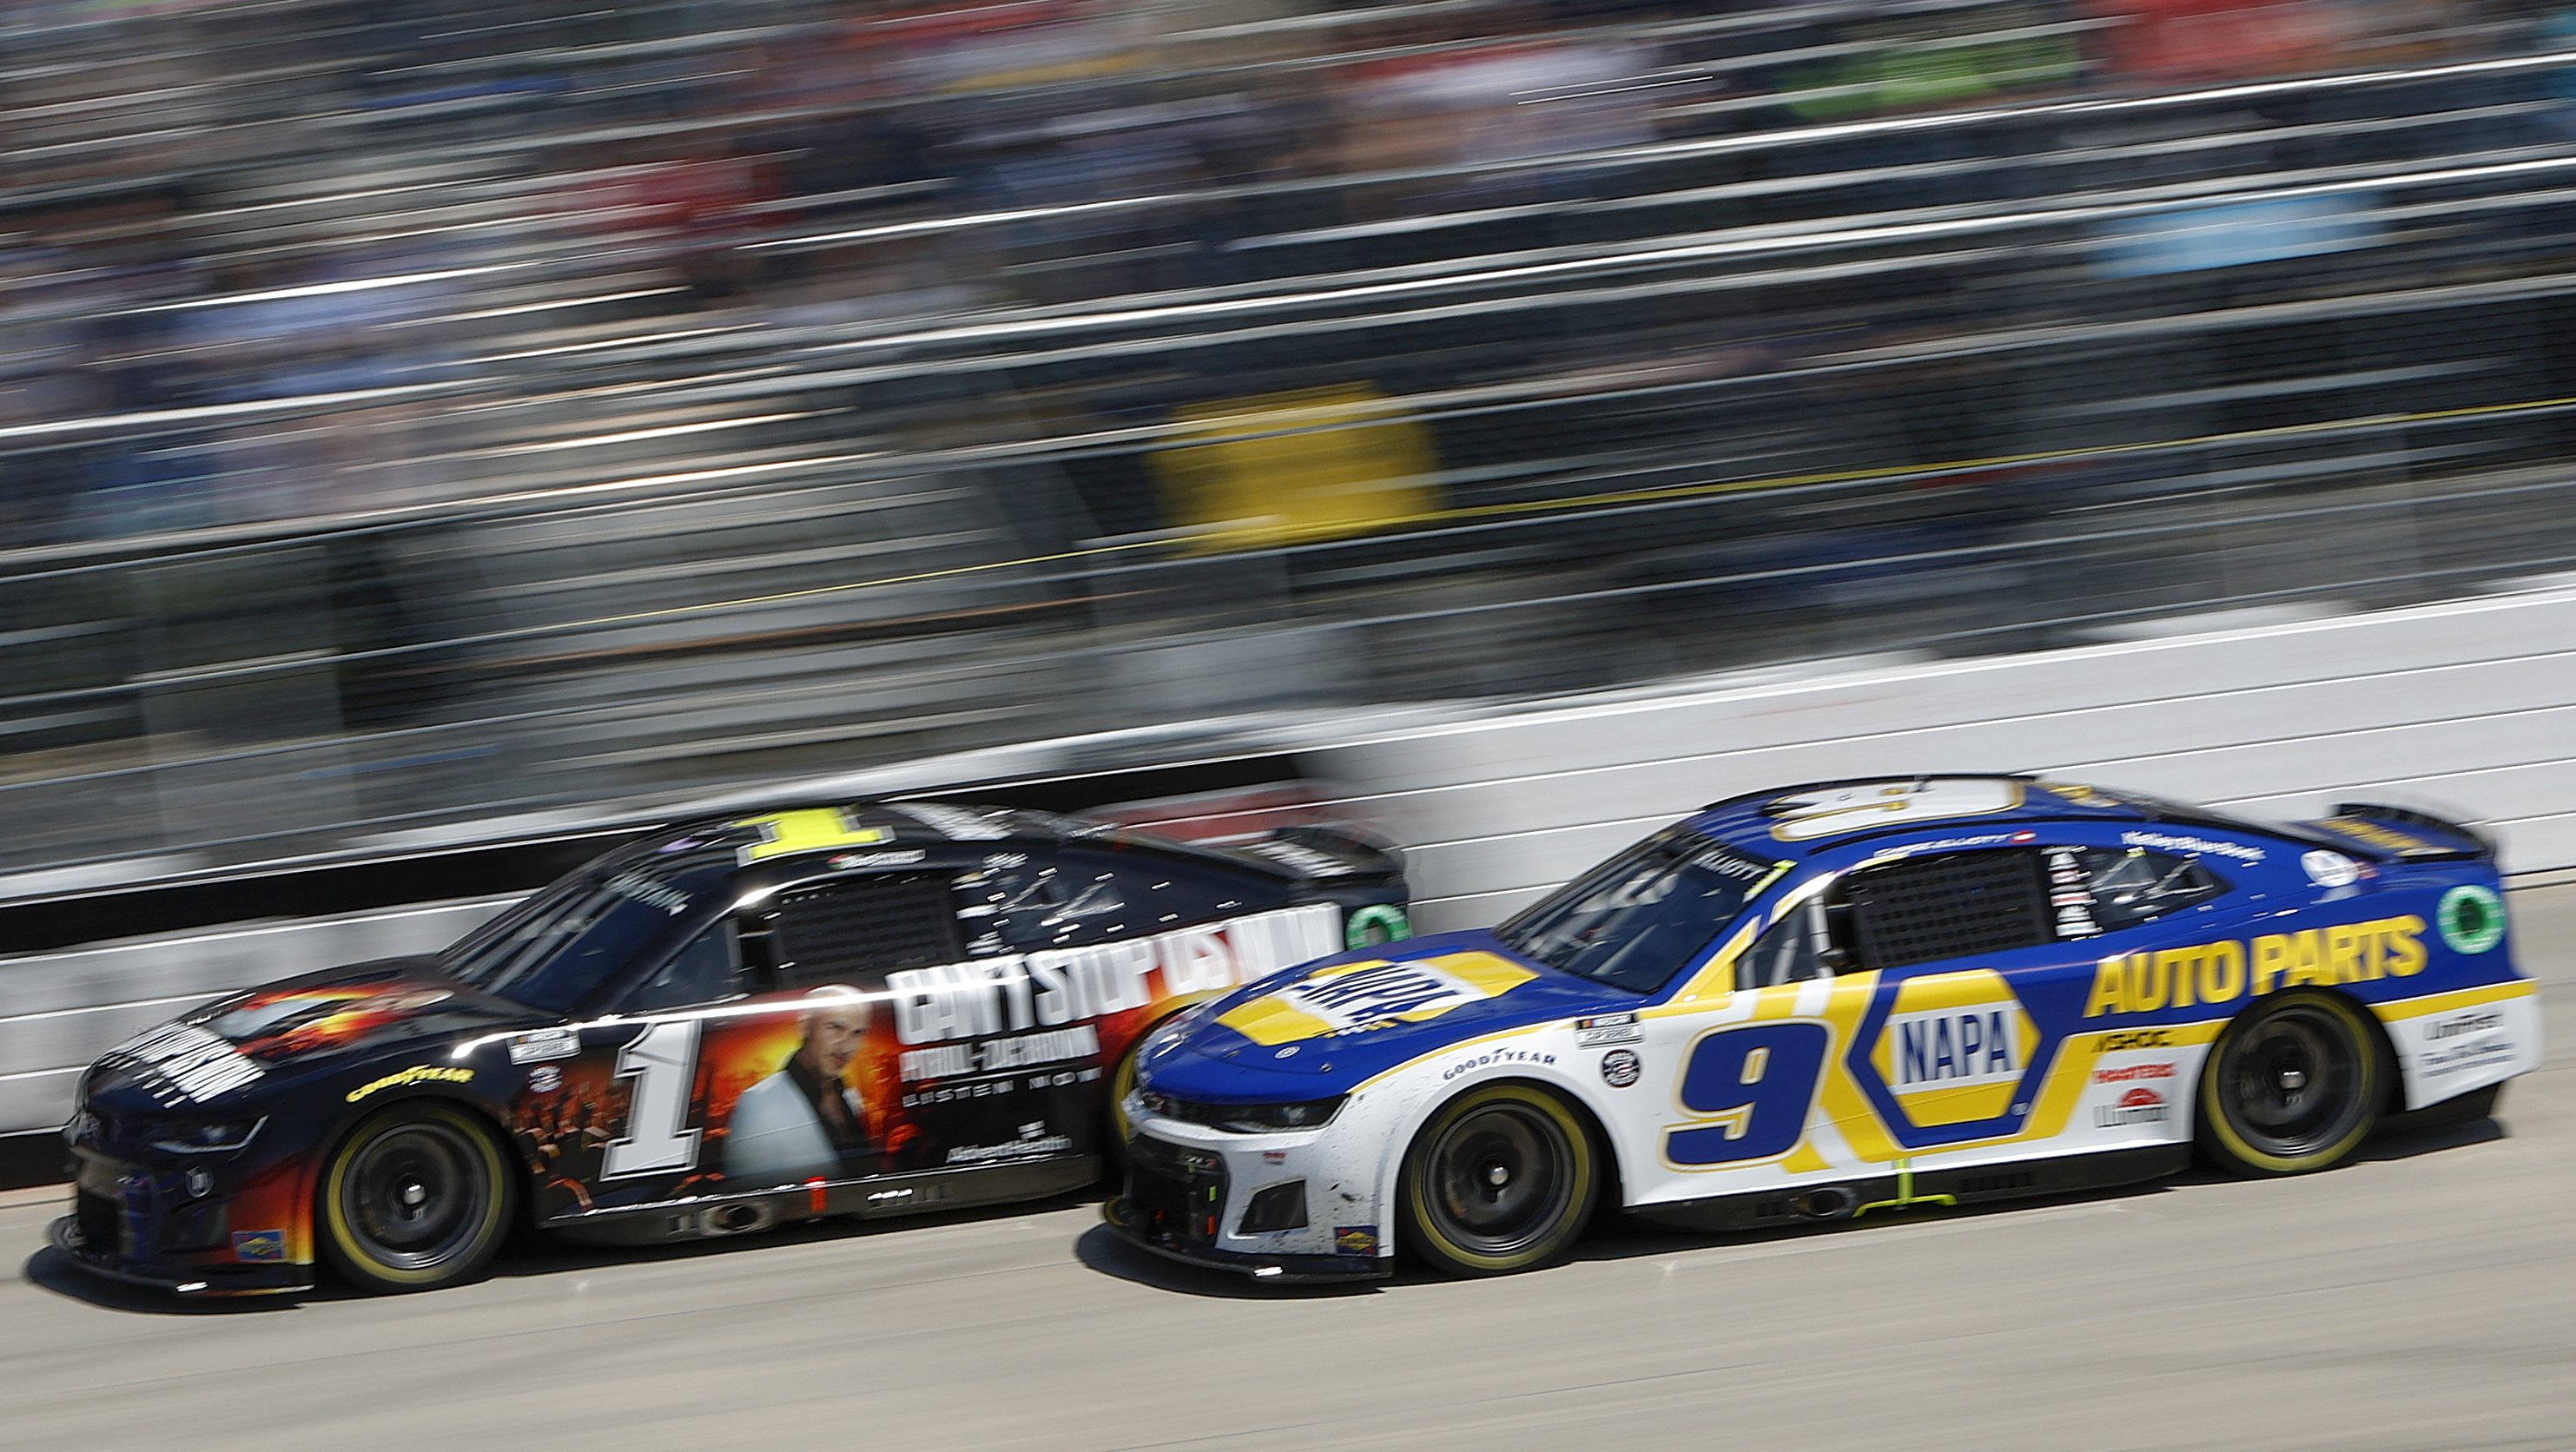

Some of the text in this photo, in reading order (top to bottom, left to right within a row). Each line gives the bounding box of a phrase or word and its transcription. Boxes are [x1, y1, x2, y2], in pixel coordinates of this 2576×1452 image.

[2082, 939, 2246, 1018] AUTO
[2249, 914, 2429, 997] PARTS
[902, 1066, 1104, 1117] LISTEN NOW
[1443, 1046, 1557, 1079] GOODYEAR
[1899, 1010, 2013, 1084] NAPA
[601, 1021, 705, 1181] 1
[1659, 1018, 1834, 1170] 9
